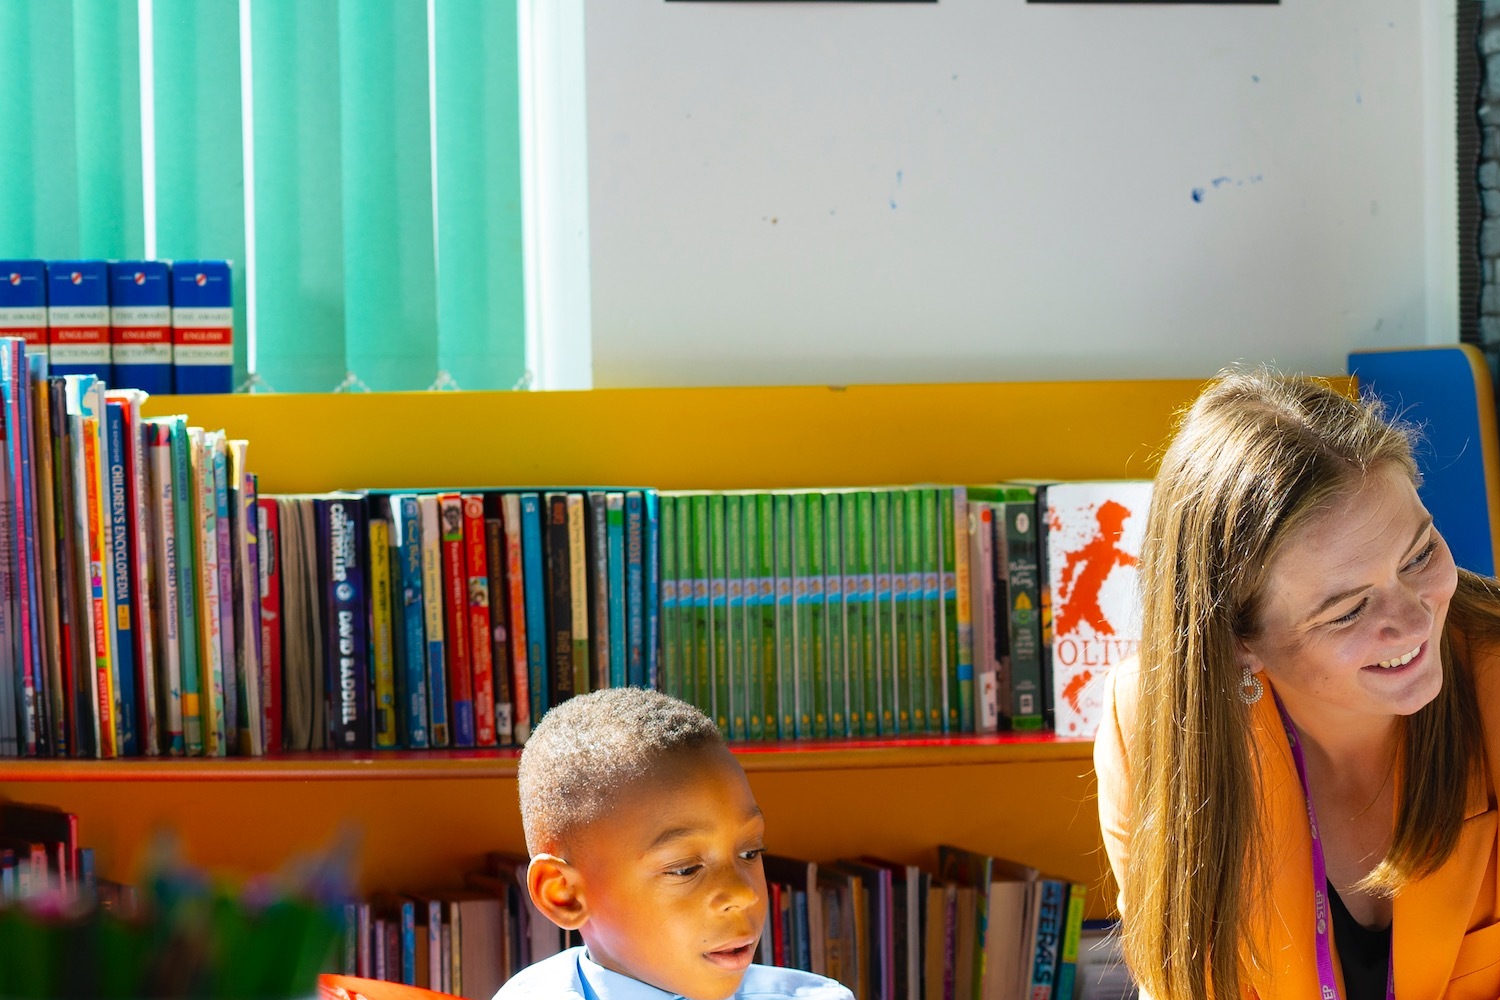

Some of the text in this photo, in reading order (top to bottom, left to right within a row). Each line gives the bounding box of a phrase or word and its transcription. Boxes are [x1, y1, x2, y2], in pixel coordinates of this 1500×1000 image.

[58, 331, 99, 340] ENGLISH
[122, 330, 163, 340] ENGLISH
[183, 331, 223, 341] ENGLISH
[111, 464, 126, 523] CHILDREN'S
[163, 484, 171, 498] My
[115, 526, 128, 600] ENCYCLOPEDIA
[165, 536, 177, 588] OXFORD
[331, 503, 347, 582] CONTROLLER
[168, 591, 178, 640] Dictionary
[338, 611, 357, 725] DAVID BADDIEL
[1058, 639, 1132, 666] OLIV
[1315, 890, 1327, 919] STEP
[1036, 902, 1059, 984] FERALS
